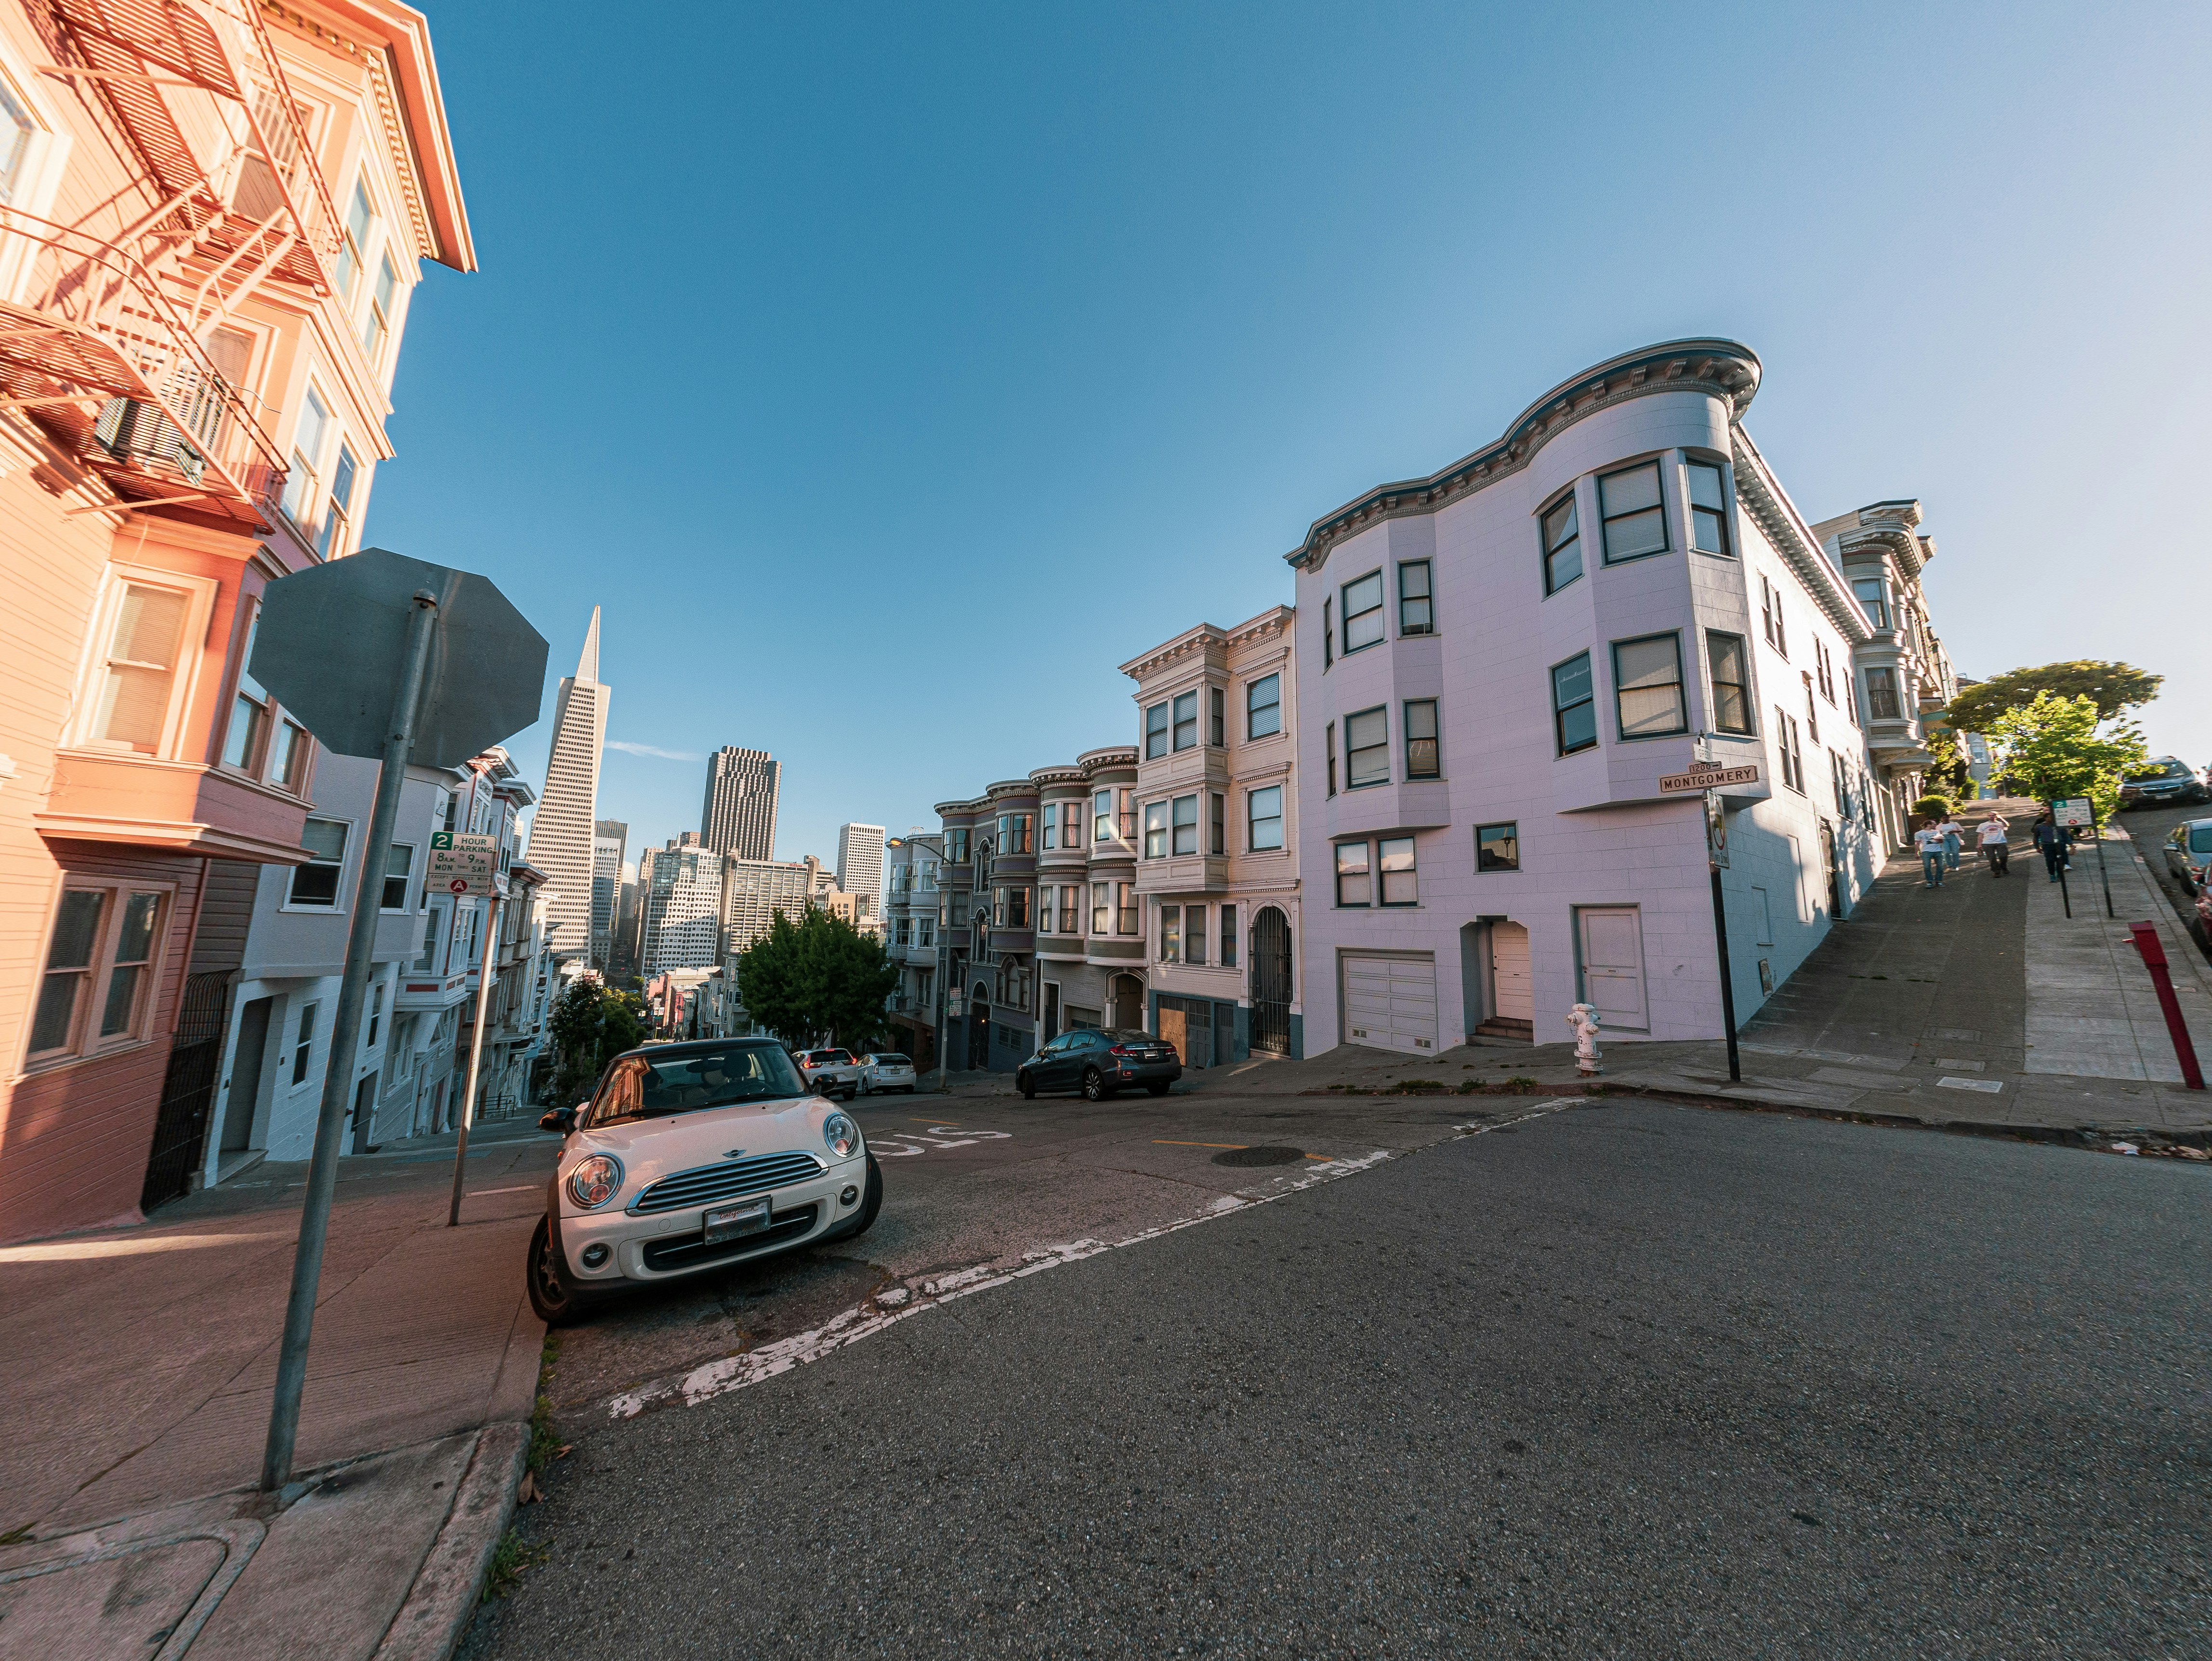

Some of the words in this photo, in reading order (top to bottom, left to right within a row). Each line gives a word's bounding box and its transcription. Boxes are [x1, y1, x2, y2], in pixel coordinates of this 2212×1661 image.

[1692, 764, 1711, 772] 1200
[1664, 769, 1751, 790] MONTGOMERY
[435, 834, 448, 847] 2
[461, 837, 487, 845] HOUR
[453, 844, 493, 854] PARKING
[452, 881, 464, 890] A
[719, 1207, 758, 1219] California
[741, 1226, 768, 1237] Francisco
